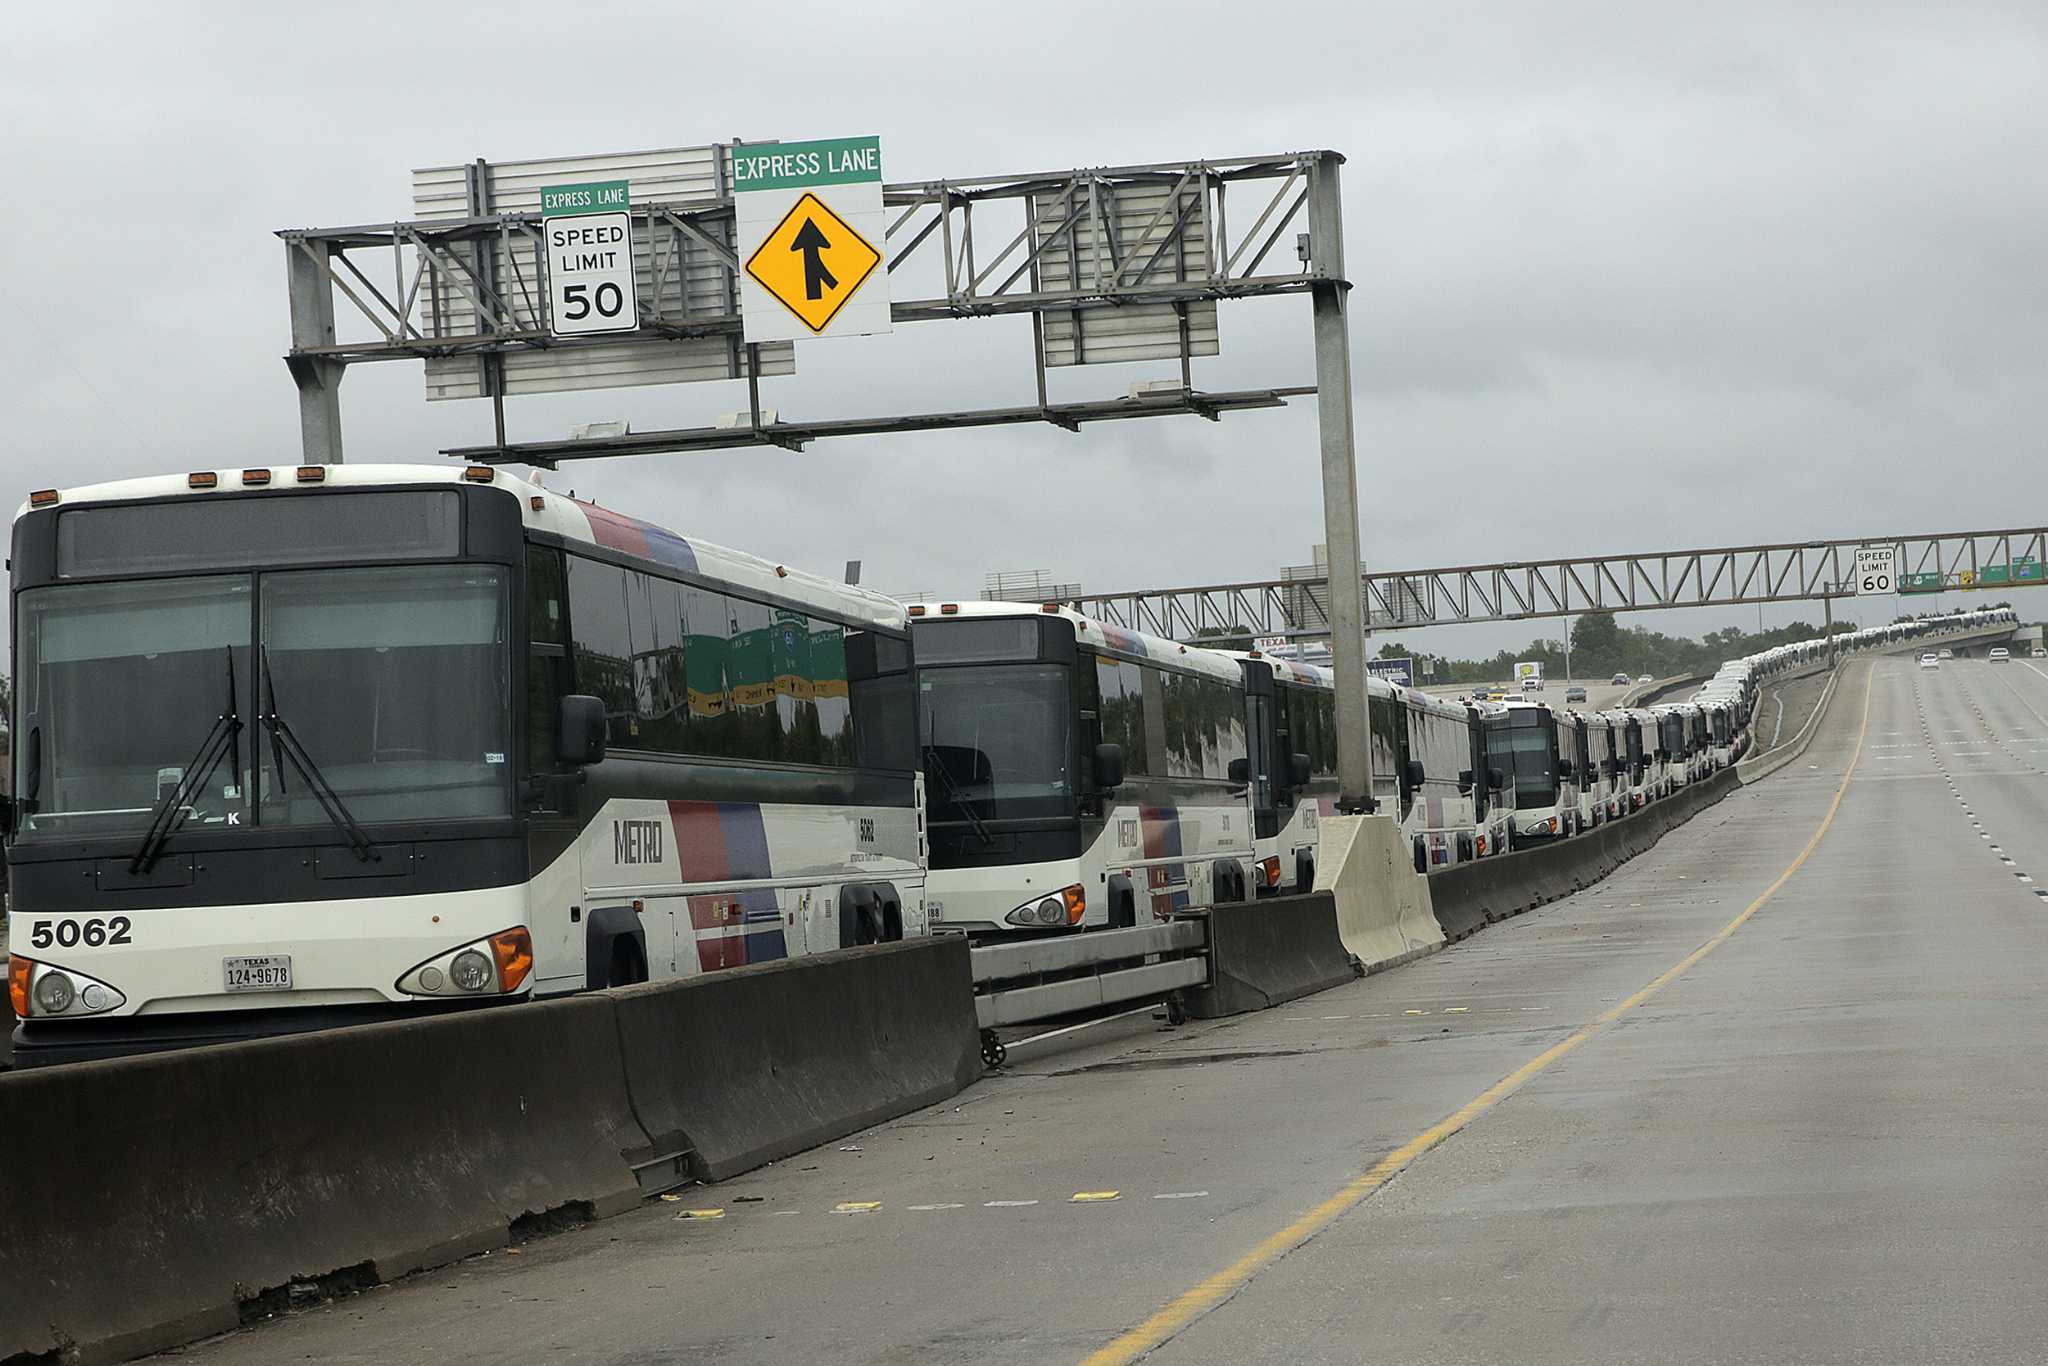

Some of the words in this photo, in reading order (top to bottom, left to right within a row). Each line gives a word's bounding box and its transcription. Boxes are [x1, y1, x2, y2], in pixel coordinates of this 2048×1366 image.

[734, 152, 820, 181] EXPRESS
[827, 147, 879, 174] LANE
[545, 192, 592, 209] EXPRESS
[597, 188, 625, 204] LANE
[553, 226, 623, 248] SPEED
[562, 251, 617, 272] LIMIT
[564, 281, 624, 320] 50
[1857, 552, 1892, 561] SPEED
[1862, 562, 1888, 572] LIMIT
[1863, 575, 1889, 591] 60
[228, 812, 241, 825] K
[614, 820, 663, 864] METRO
[31, 916, 132, 949] 5062
[244, 958, 270, 966] TEXAS
